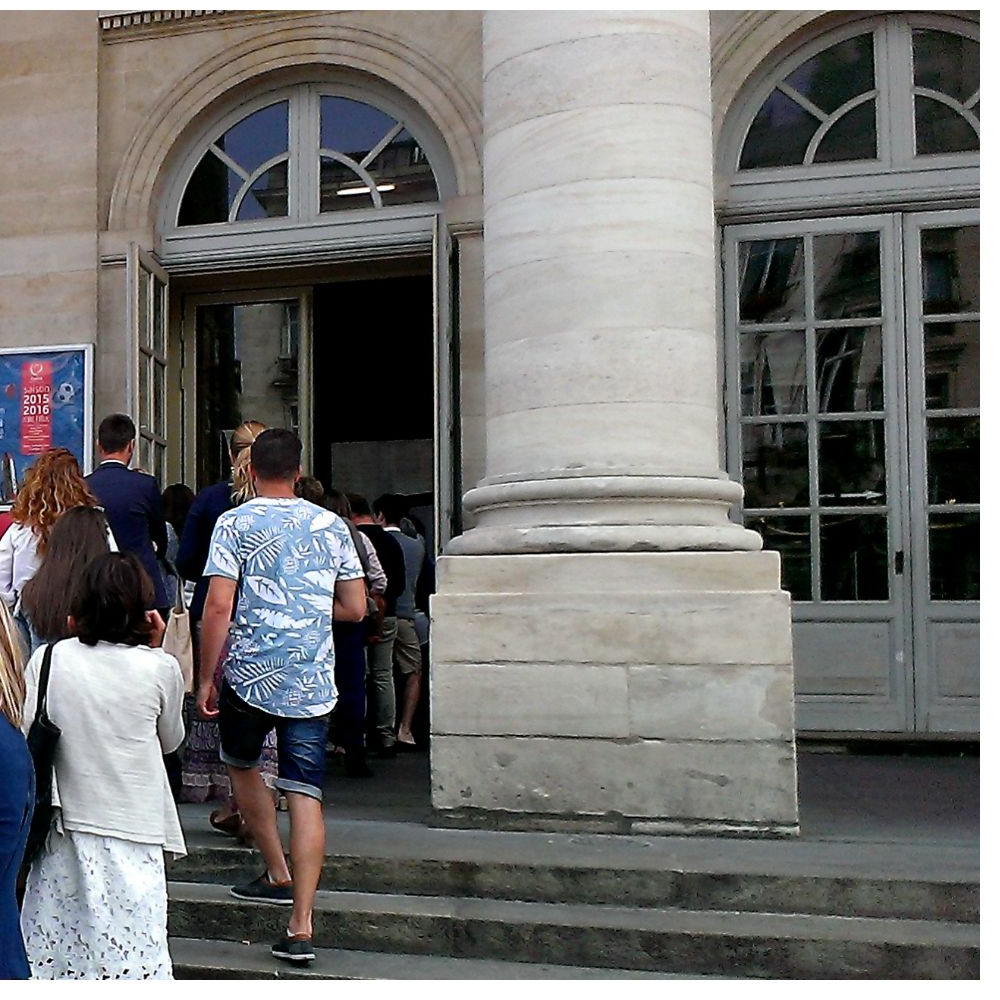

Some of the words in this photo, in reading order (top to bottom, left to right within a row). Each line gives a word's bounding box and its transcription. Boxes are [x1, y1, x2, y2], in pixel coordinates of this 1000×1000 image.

[23, 385, 50, 394] saison
[23, 394, 50, 405] 2015
[23, 405, 50, 416] 2016
